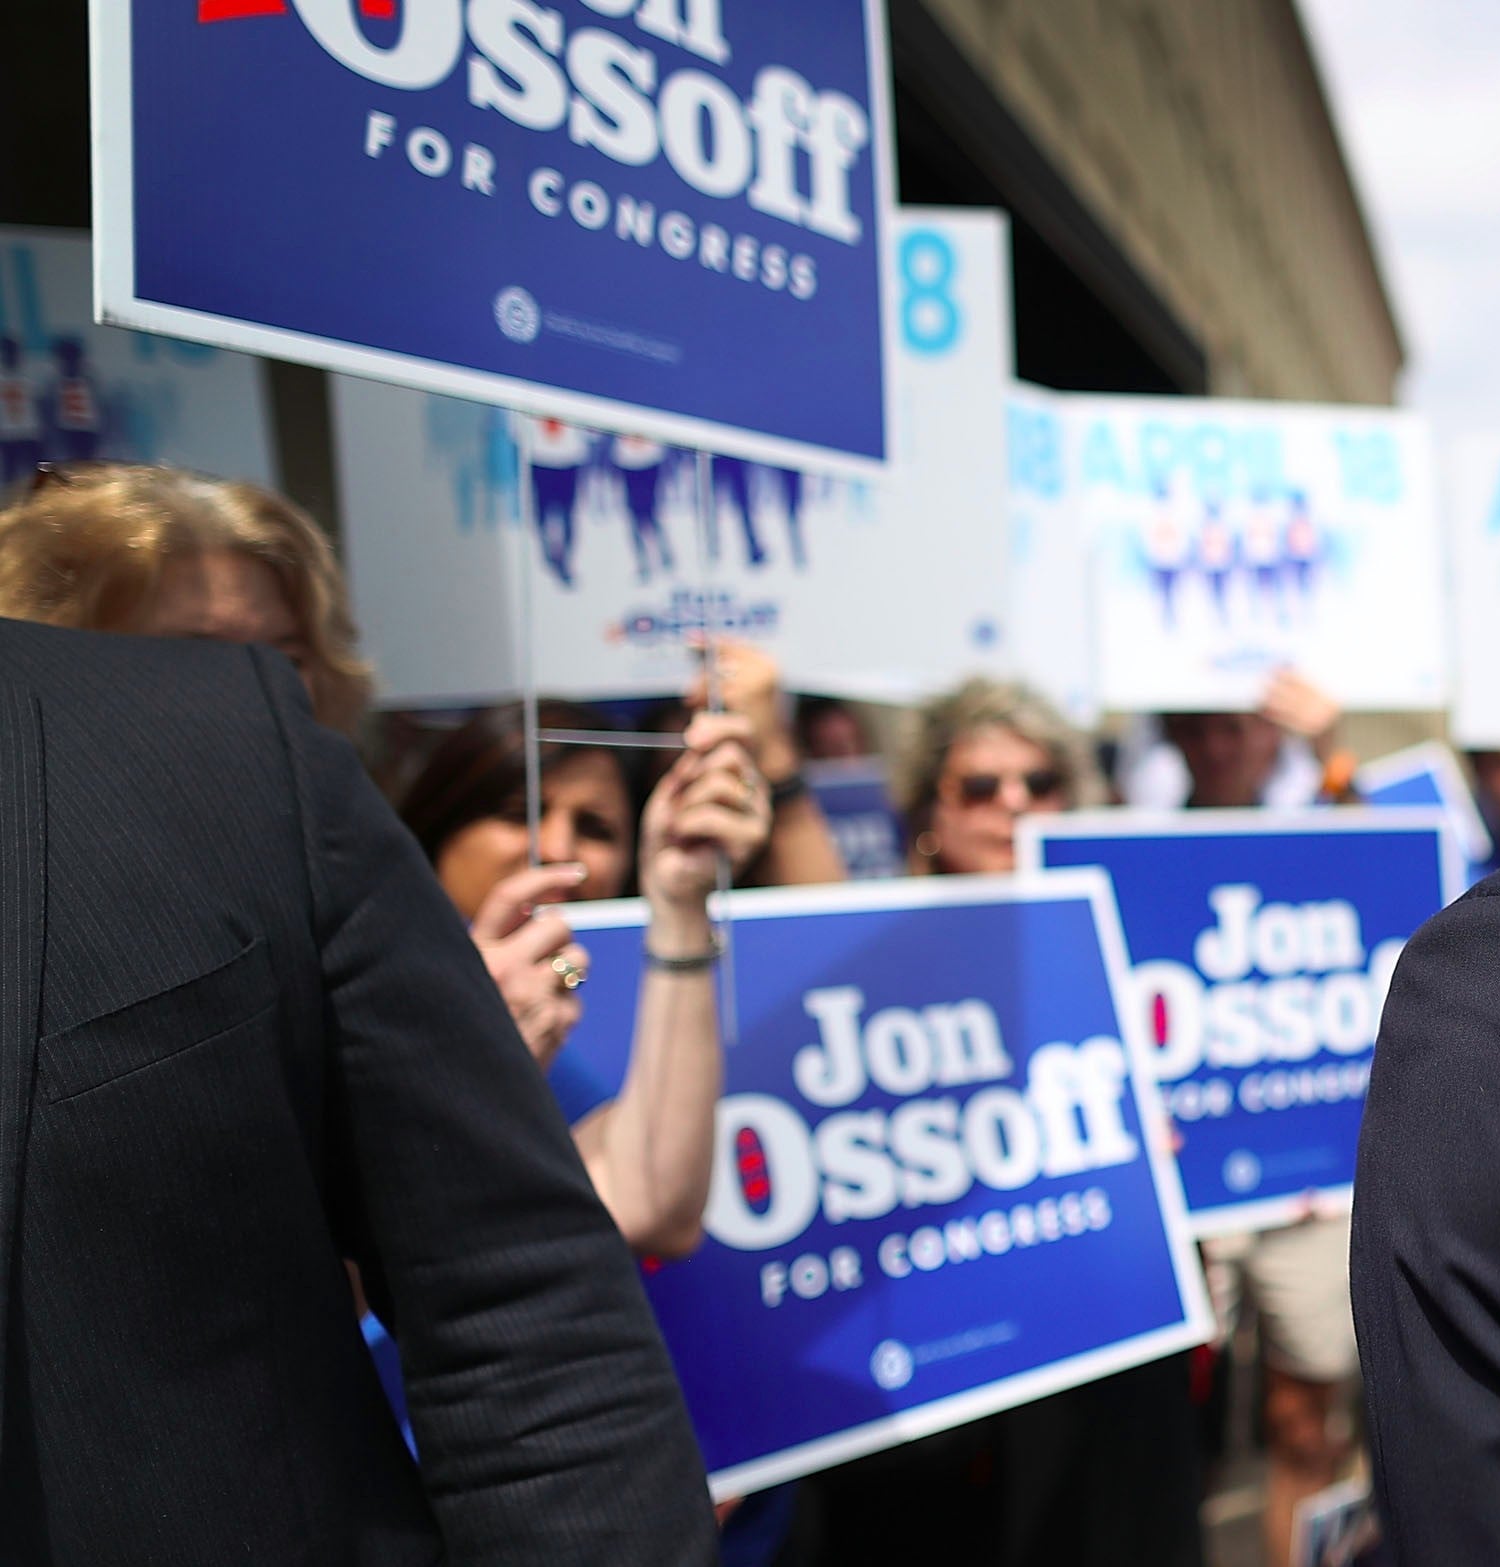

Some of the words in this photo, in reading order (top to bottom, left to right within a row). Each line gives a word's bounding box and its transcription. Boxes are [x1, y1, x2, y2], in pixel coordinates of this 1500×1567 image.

[363, 109, 498, 197] FOR
[527, 166, 819, 301] CONGRESS
[1081, 418, 1304, 500] APRIL
[1194, 883, 1366, 980] Jon
[793, 984, 1013, 1107] Jon
[703, 1036, 1138, 1251] Ossoff
[759, 1246, 862, 1308] FOR
[877, 1187, 1112, 1278] CONGRESS
